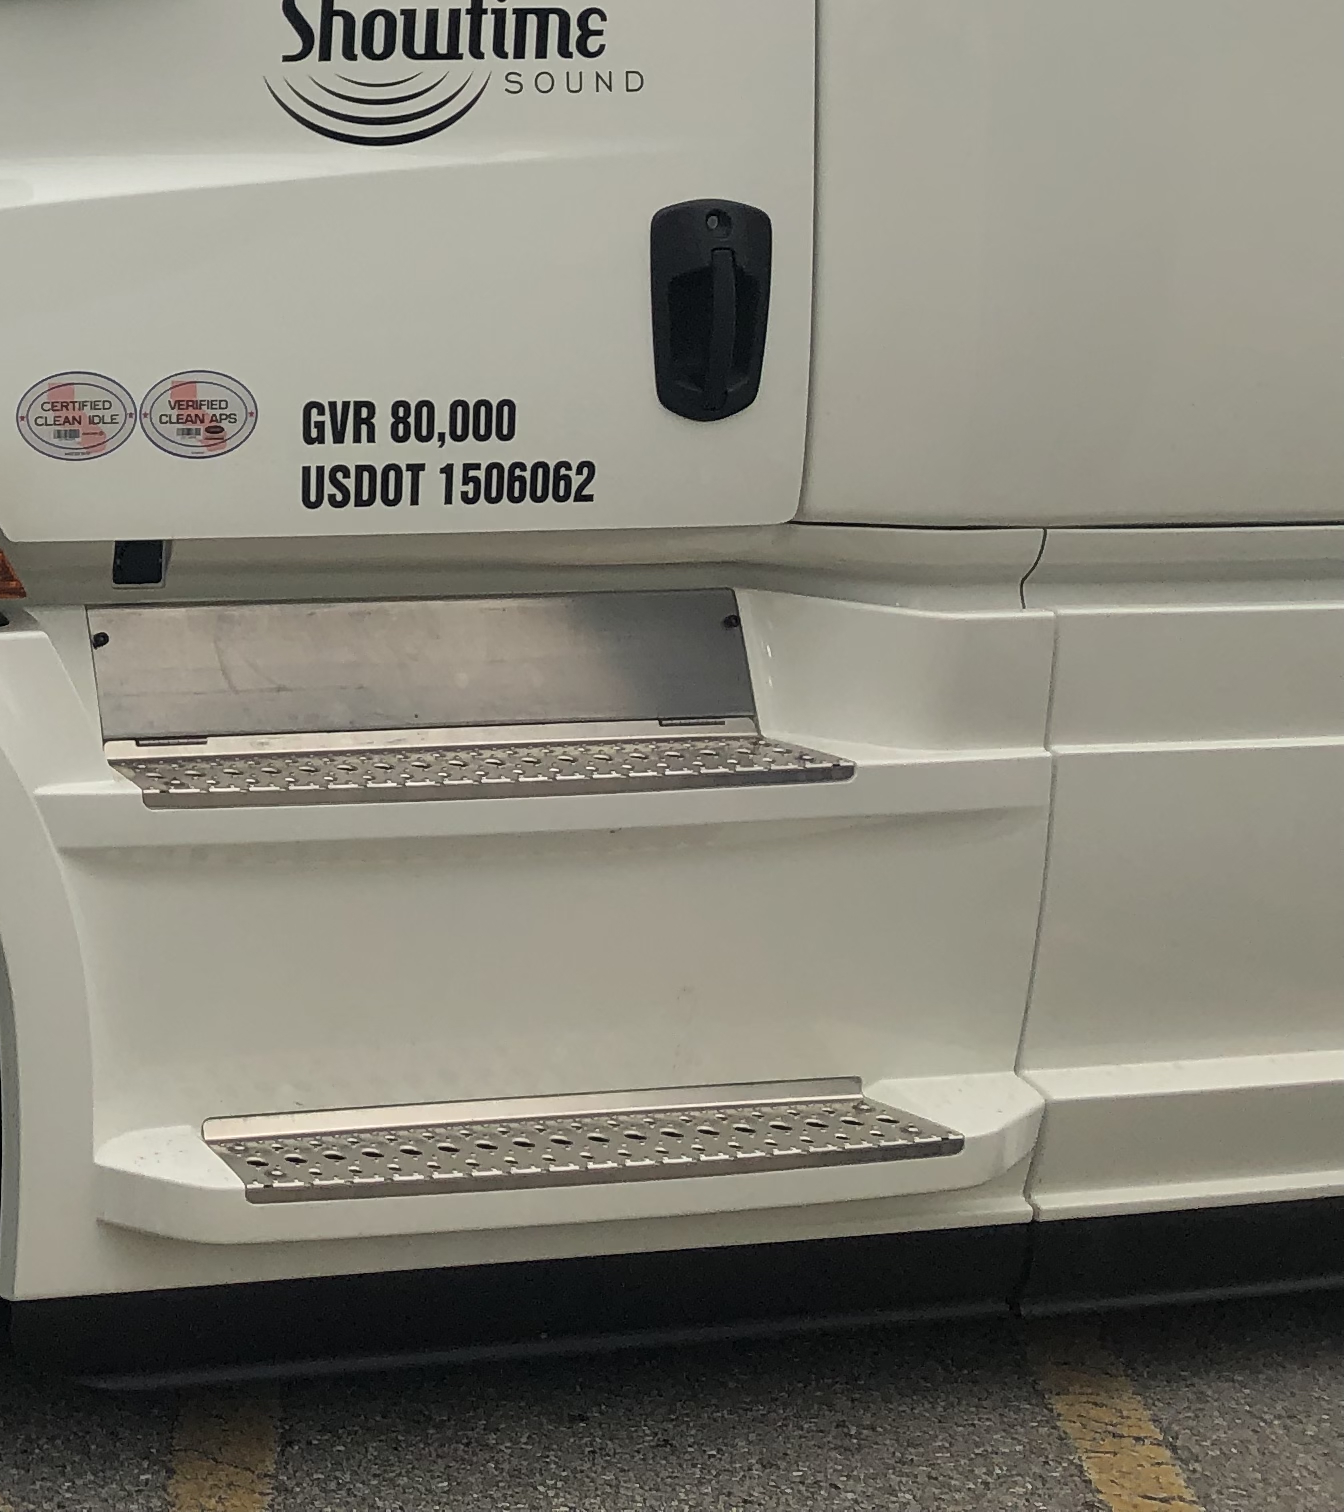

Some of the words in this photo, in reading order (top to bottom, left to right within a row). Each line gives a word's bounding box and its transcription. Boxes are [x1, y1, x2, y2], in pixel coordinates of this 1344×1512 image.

[504, 70, 645, 95] SOUND
[40, 399, 113, 412] CERTIFIED
[168, 399, 229, 410] VERIFIED
[34, 415, 82, 426] CLEAN
[88, 414, 120, 425] IDLE
[158, 413, 205, 425] CLEAN
[209, 413, 238, 424] APS
[302, 400, 377, 445] GVR
[390, 398, 517, 448] 80,000
[301, 463, 426, 509] USDOT
[438, 460, 596, 505] 1506062
